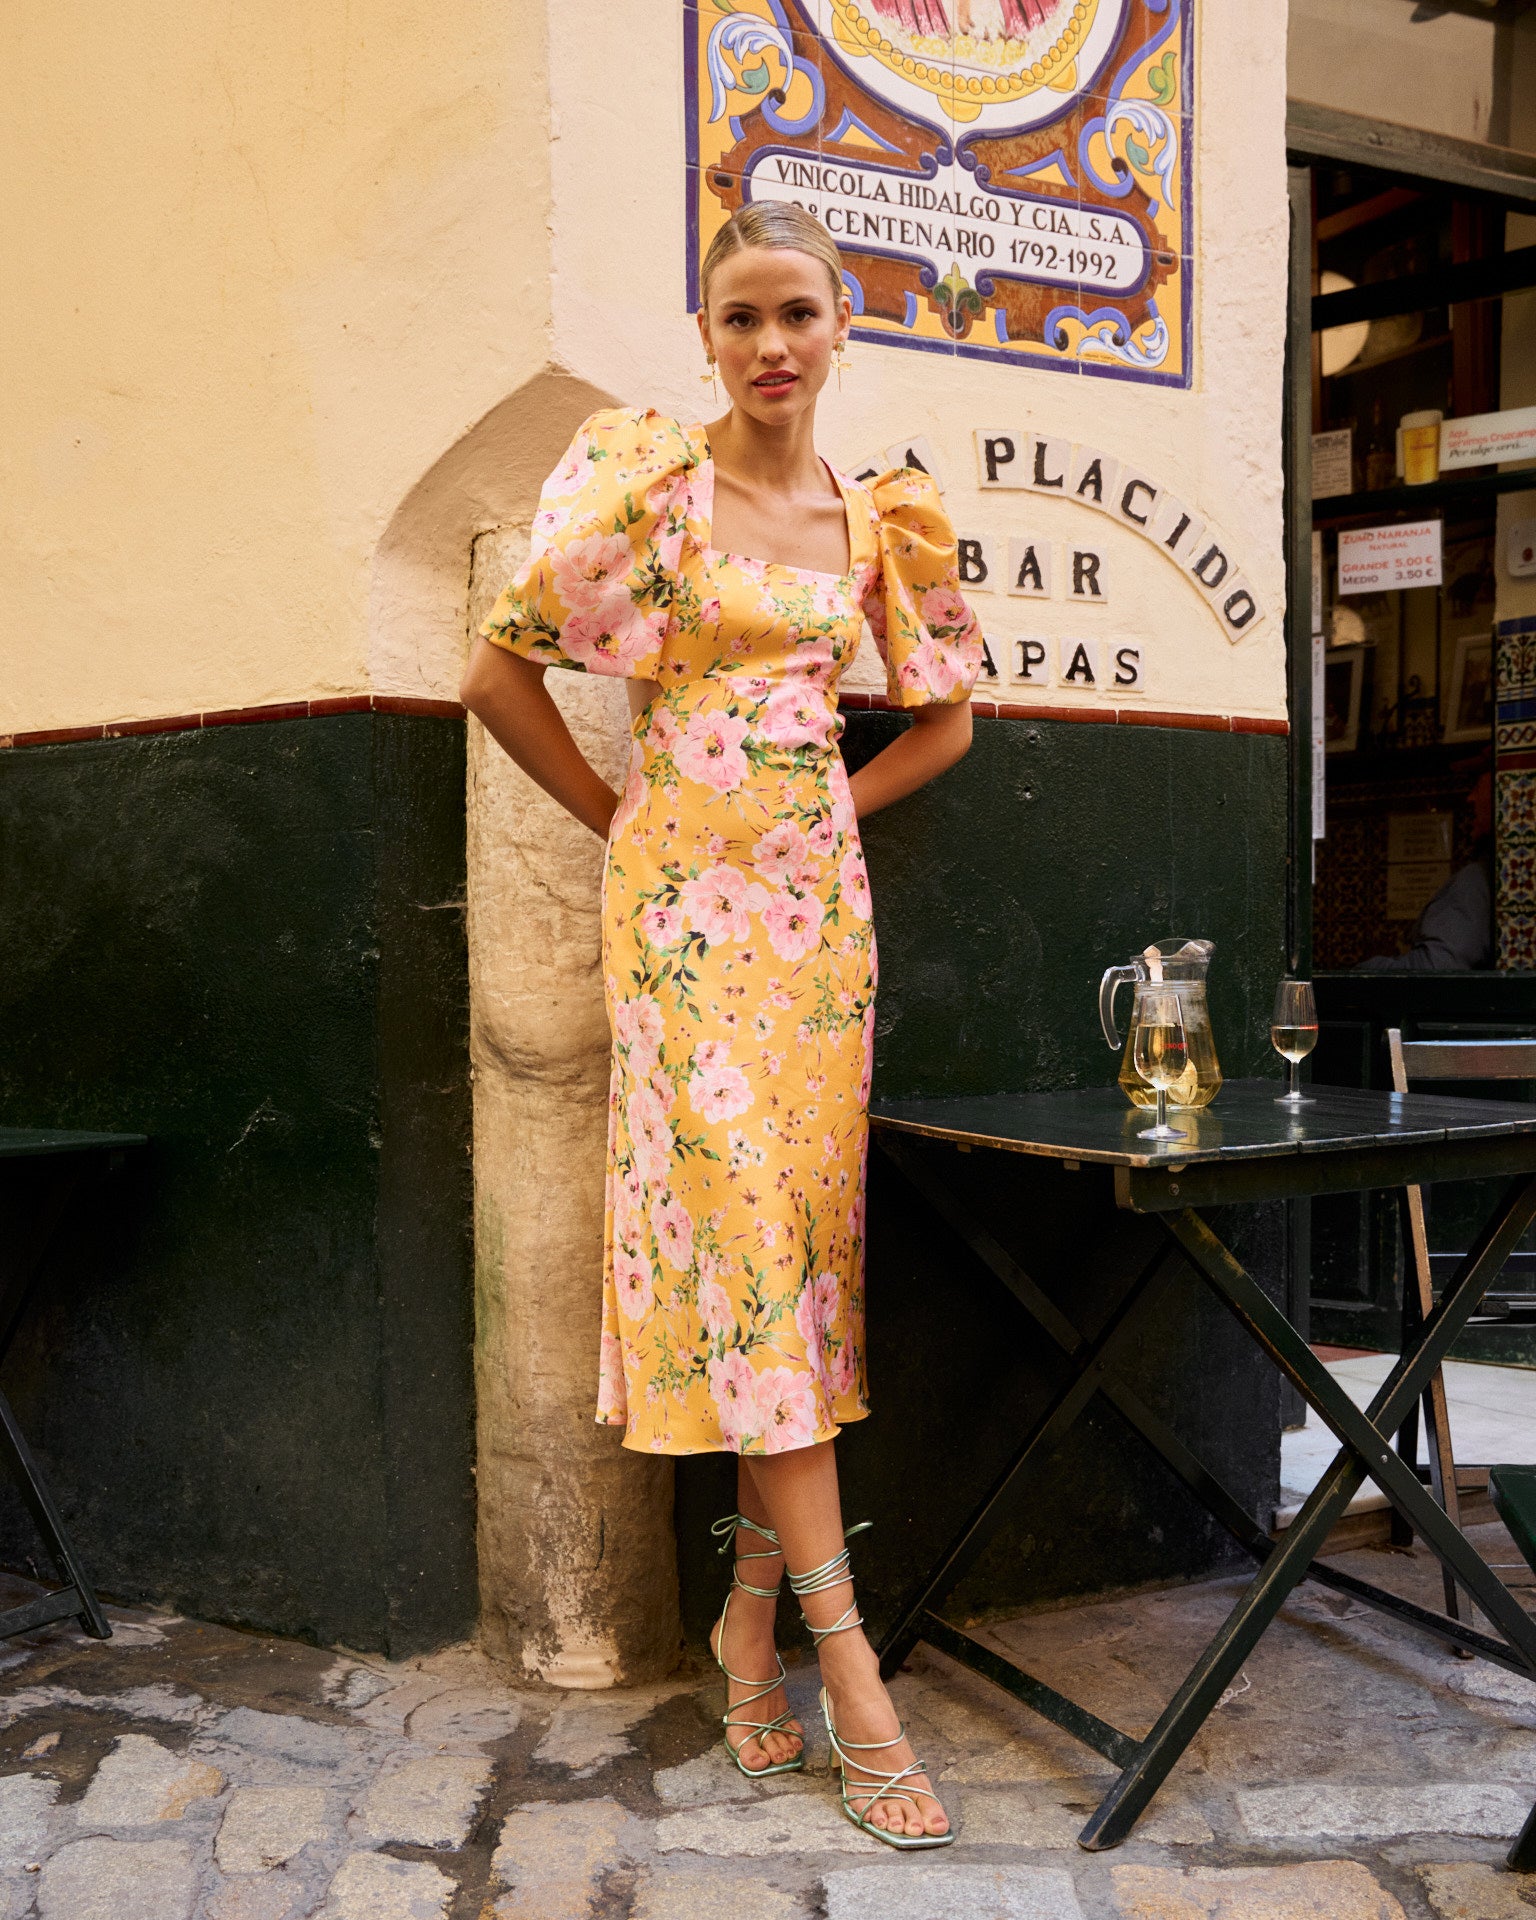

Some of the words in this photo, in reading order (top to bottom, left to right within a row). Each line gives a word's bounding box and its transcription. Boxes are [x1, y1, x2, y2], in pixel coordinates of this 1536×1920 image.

[775, 158, 891, 203] VINICOLA
[898, 181, 1001, 222] HIDALGO
[1009, 202, 1025, 226] Y
[1032, 207, 1080, 237] CIA.
[1088, 217, 1131, 247] S.A.
[825, 207, 995, 259] CENTENARIO
[1009, 238, 1118, 280] 1792-1992
[984, 436, 1257, 629] PLACIDO
[1377, 528, 1431, 540] NARANJA
[958, 539, 1101, 595] BAR
[1342, 561, 1389, 573] GRANDE
[1343, 575, 1380, 587] MEDIO
[1395, 569, 1423, 582] 3.50
[981, 638, 1140, 685] APAS
